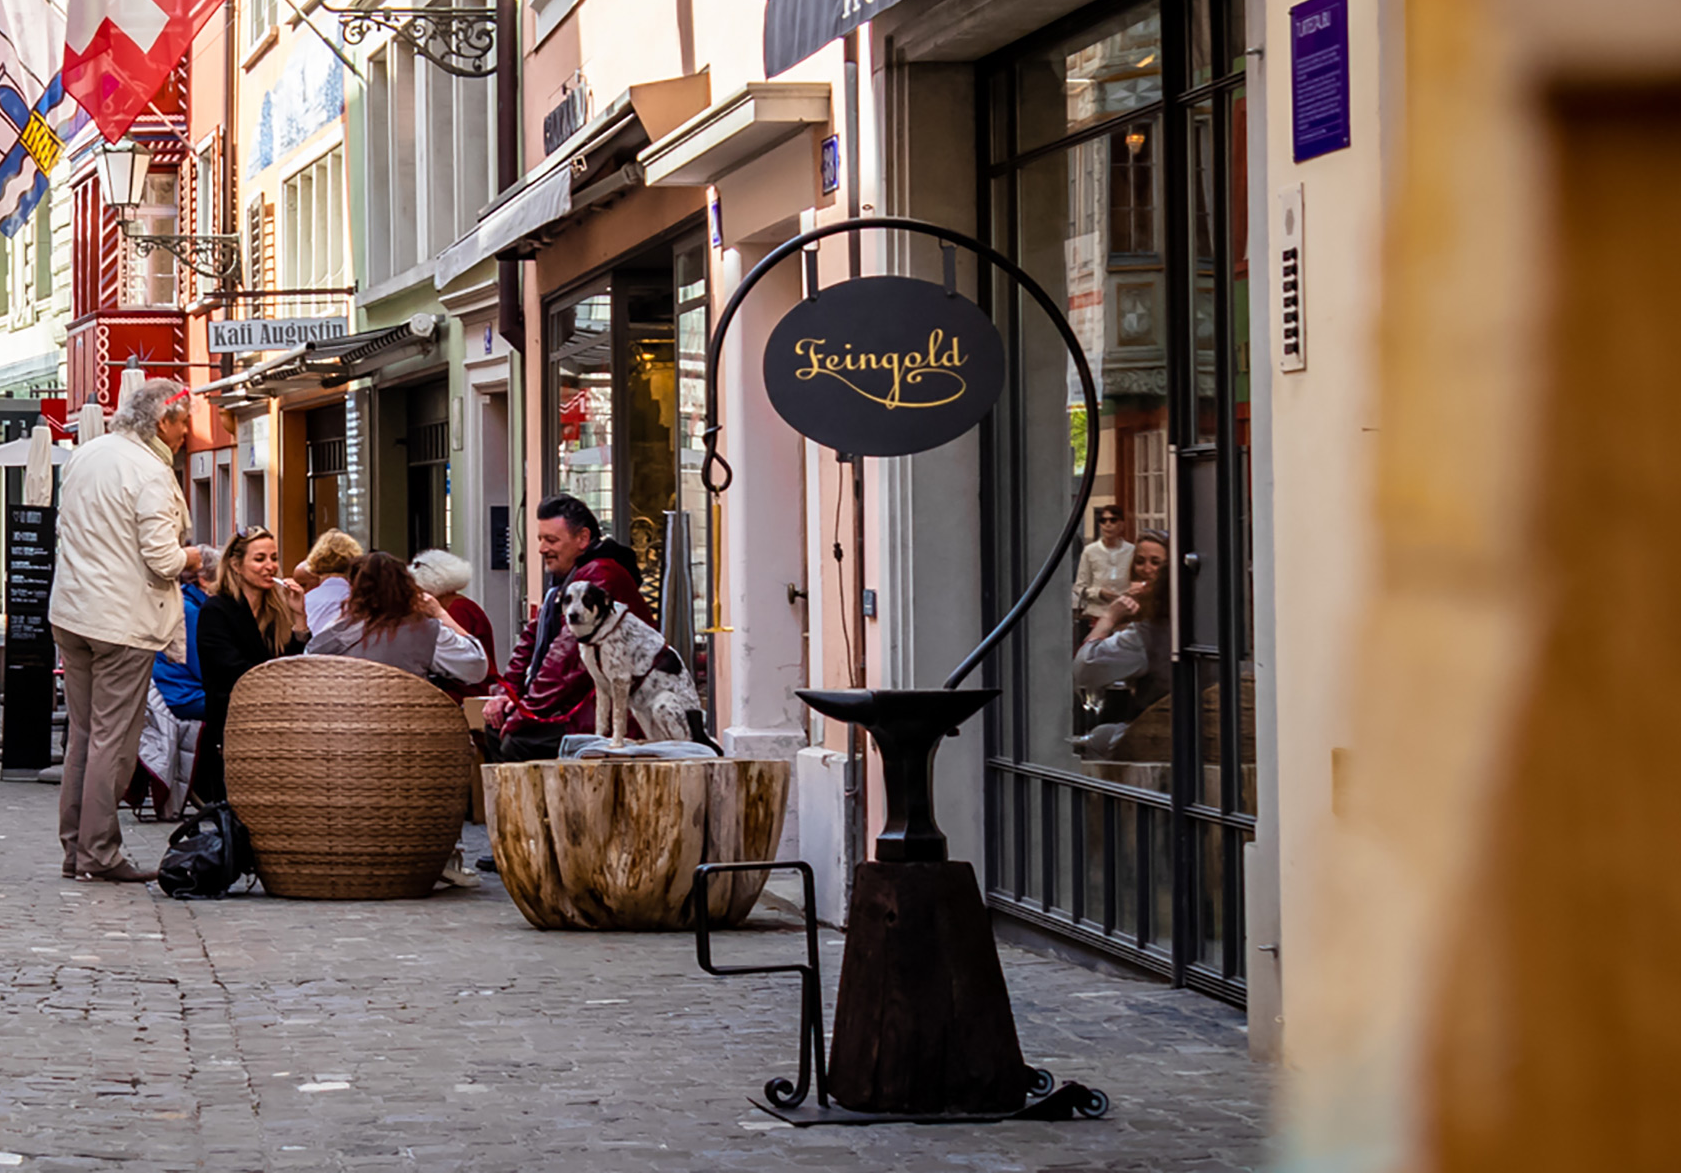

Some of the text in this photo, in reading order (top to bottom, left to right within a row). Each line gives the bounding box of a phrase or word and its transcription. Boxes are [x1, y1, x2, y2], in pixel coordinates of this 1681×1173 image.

[213, 320, 344, 347] Kafi Augustin
[794, 328, 969, 410] Feingold
